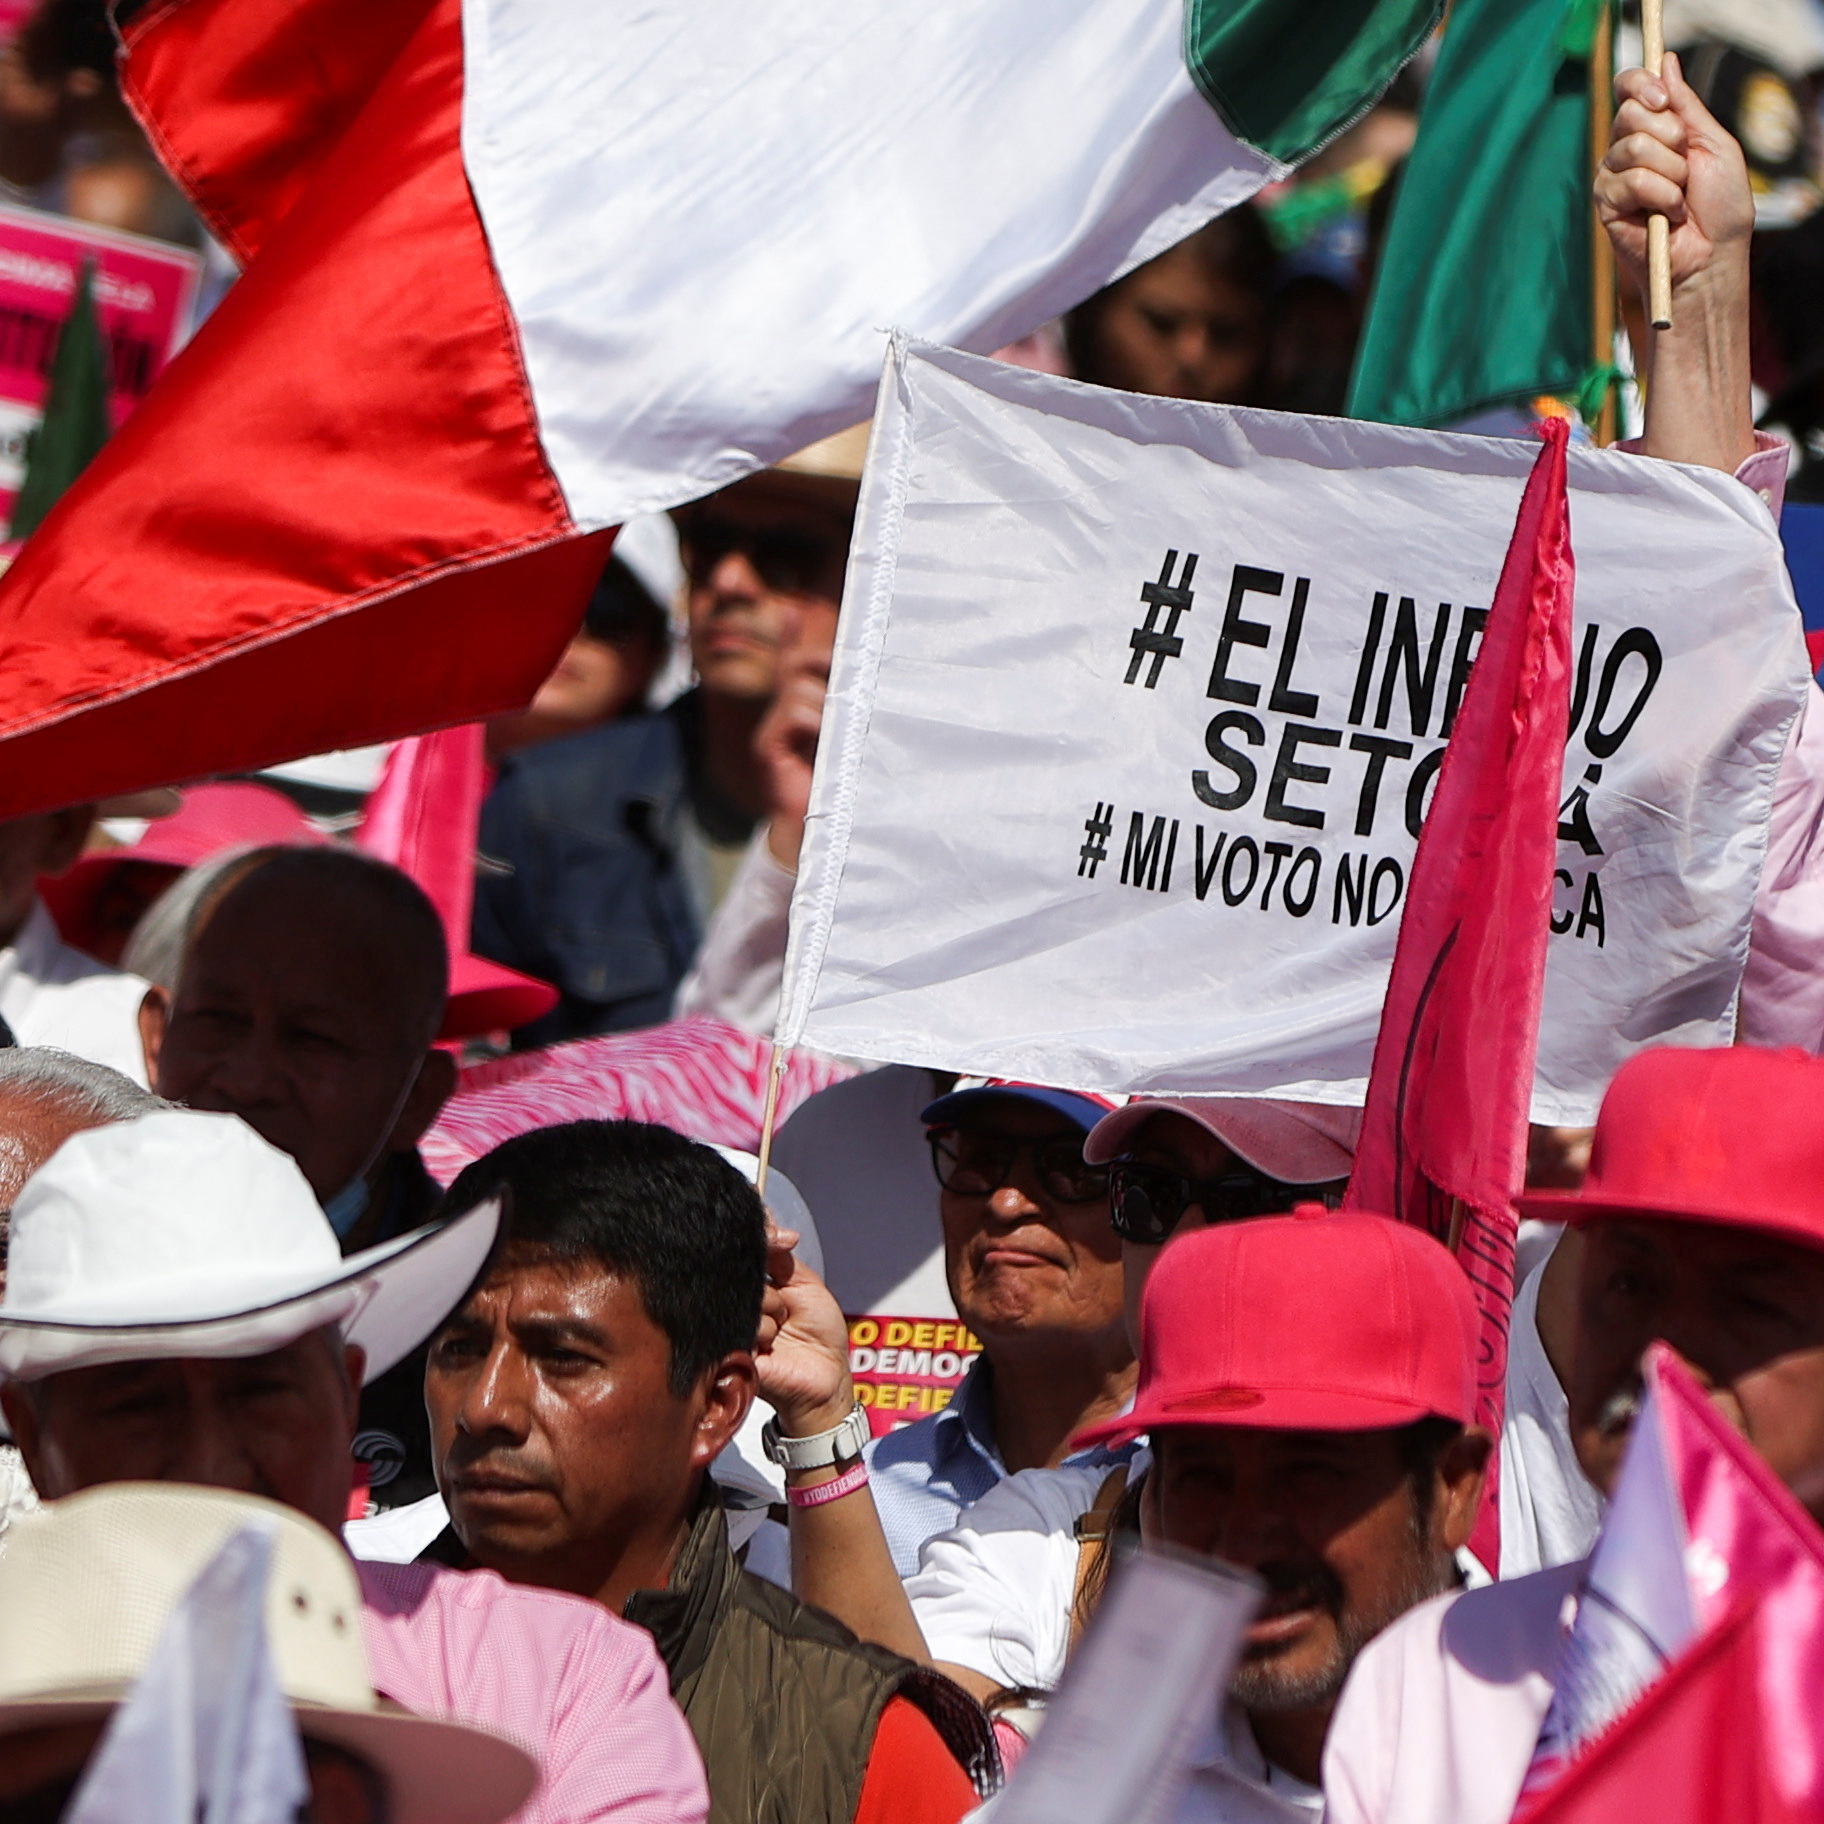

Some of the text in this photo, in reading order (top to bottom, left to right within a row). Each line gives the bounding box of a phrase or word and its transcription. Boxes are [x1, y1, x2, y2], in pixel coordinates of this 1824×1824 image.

[1206, 564, 1317, 717] EL
[1120, 810, 1181, 894] MI
[1194, 824, 1322, 919] VOTO
[1332, 850, 1405, 927] NO
[885, 1321, 985, 1352] DEFIE
[853, 1381, 955, 1413] DEFIE
